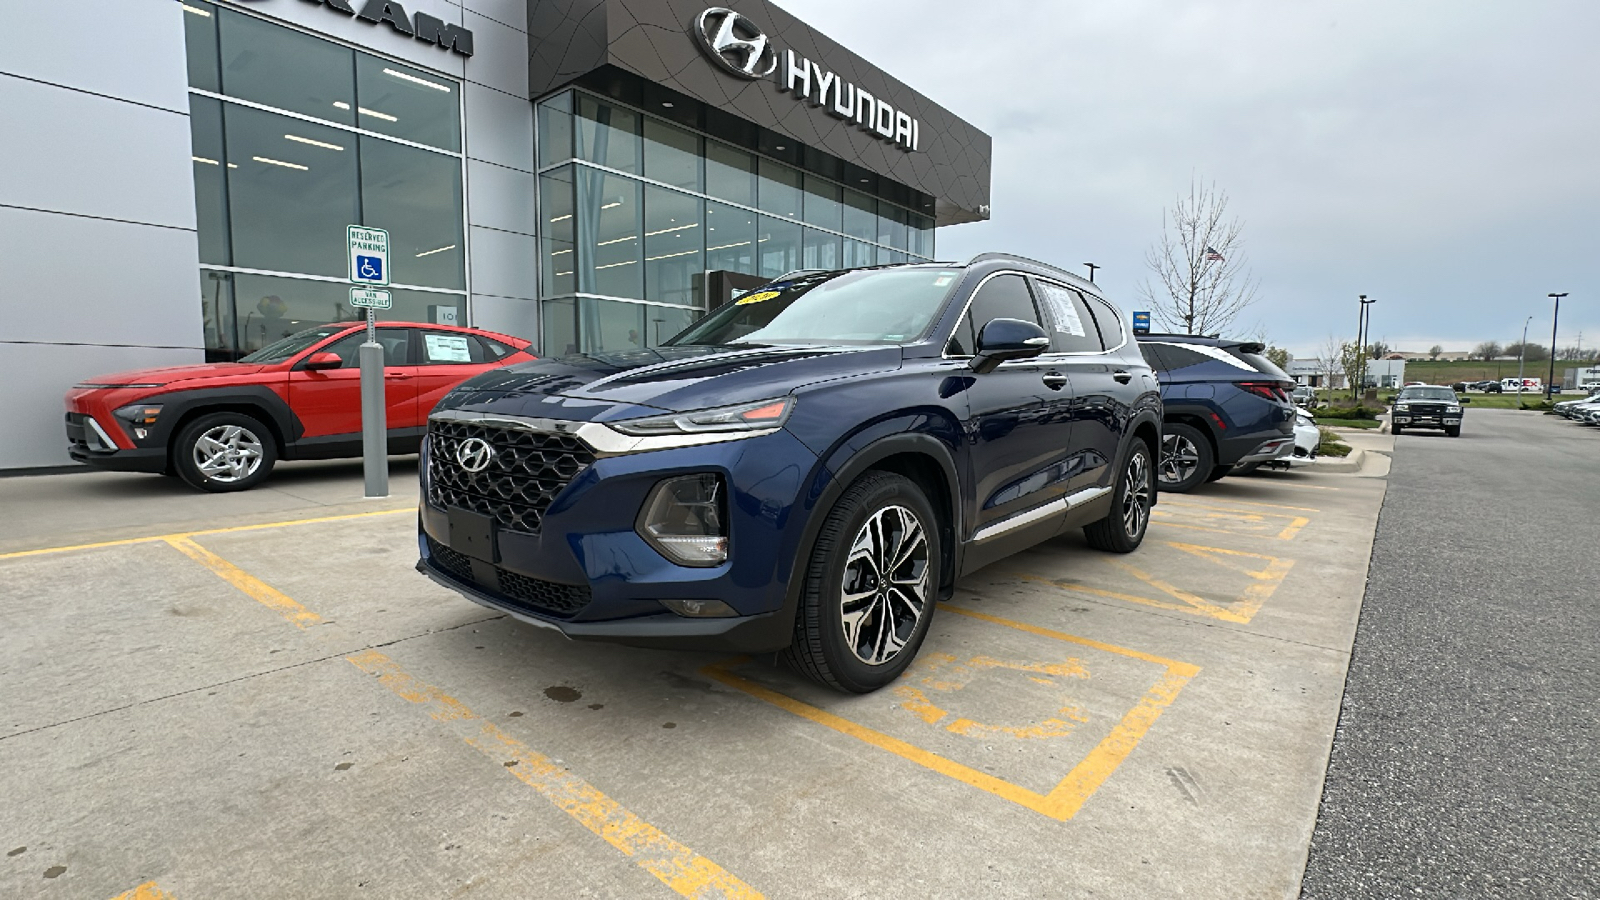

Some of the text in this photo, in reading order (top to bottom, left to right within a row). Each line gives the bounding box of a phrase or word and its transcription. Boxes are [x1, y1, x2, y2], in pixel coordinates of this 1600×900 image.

[302, 0, 474, 57] AM
[786, 48, 919, 151] HYUNDAI
[351, 231, 385, 243] RESERVED
[351, 240, 386, 253] PARKING
